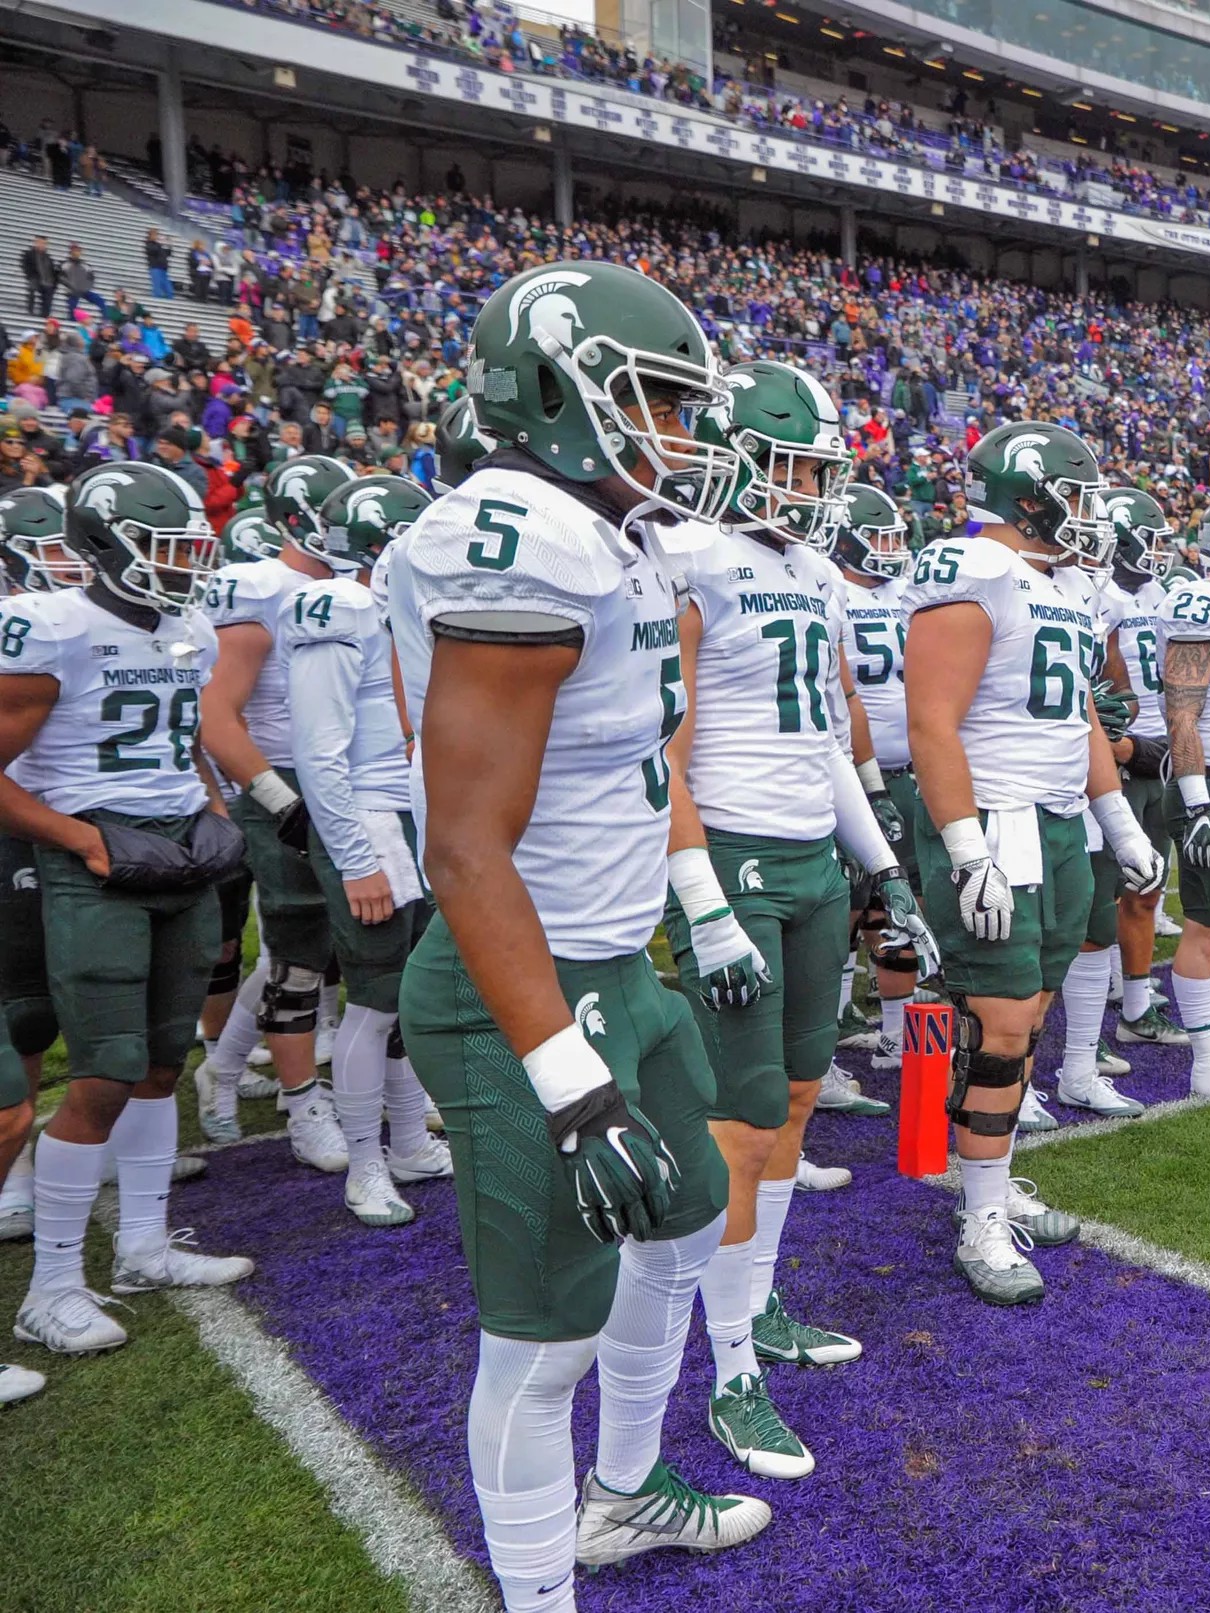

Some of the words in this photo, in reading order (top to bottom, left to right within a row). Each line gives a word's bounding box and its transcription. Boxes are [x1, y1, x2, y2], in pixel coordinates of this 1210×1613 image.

[466, 499, 528, 572] 5
[913, 547, 965, 586] 65
[294, 592, 334, 629] 14
[738, 592, 813, 615] MICHIGAN
[846, 608, 891, 620] MICHIGAN
[1027, 603, 1077, 625] MICHIGAN
[0, 612, 32, 658] 8
[101, 669, 176, 686] MICHIGAN
[97, 688, 199, 773] 28
[925, 1013, 949, 1056] N
